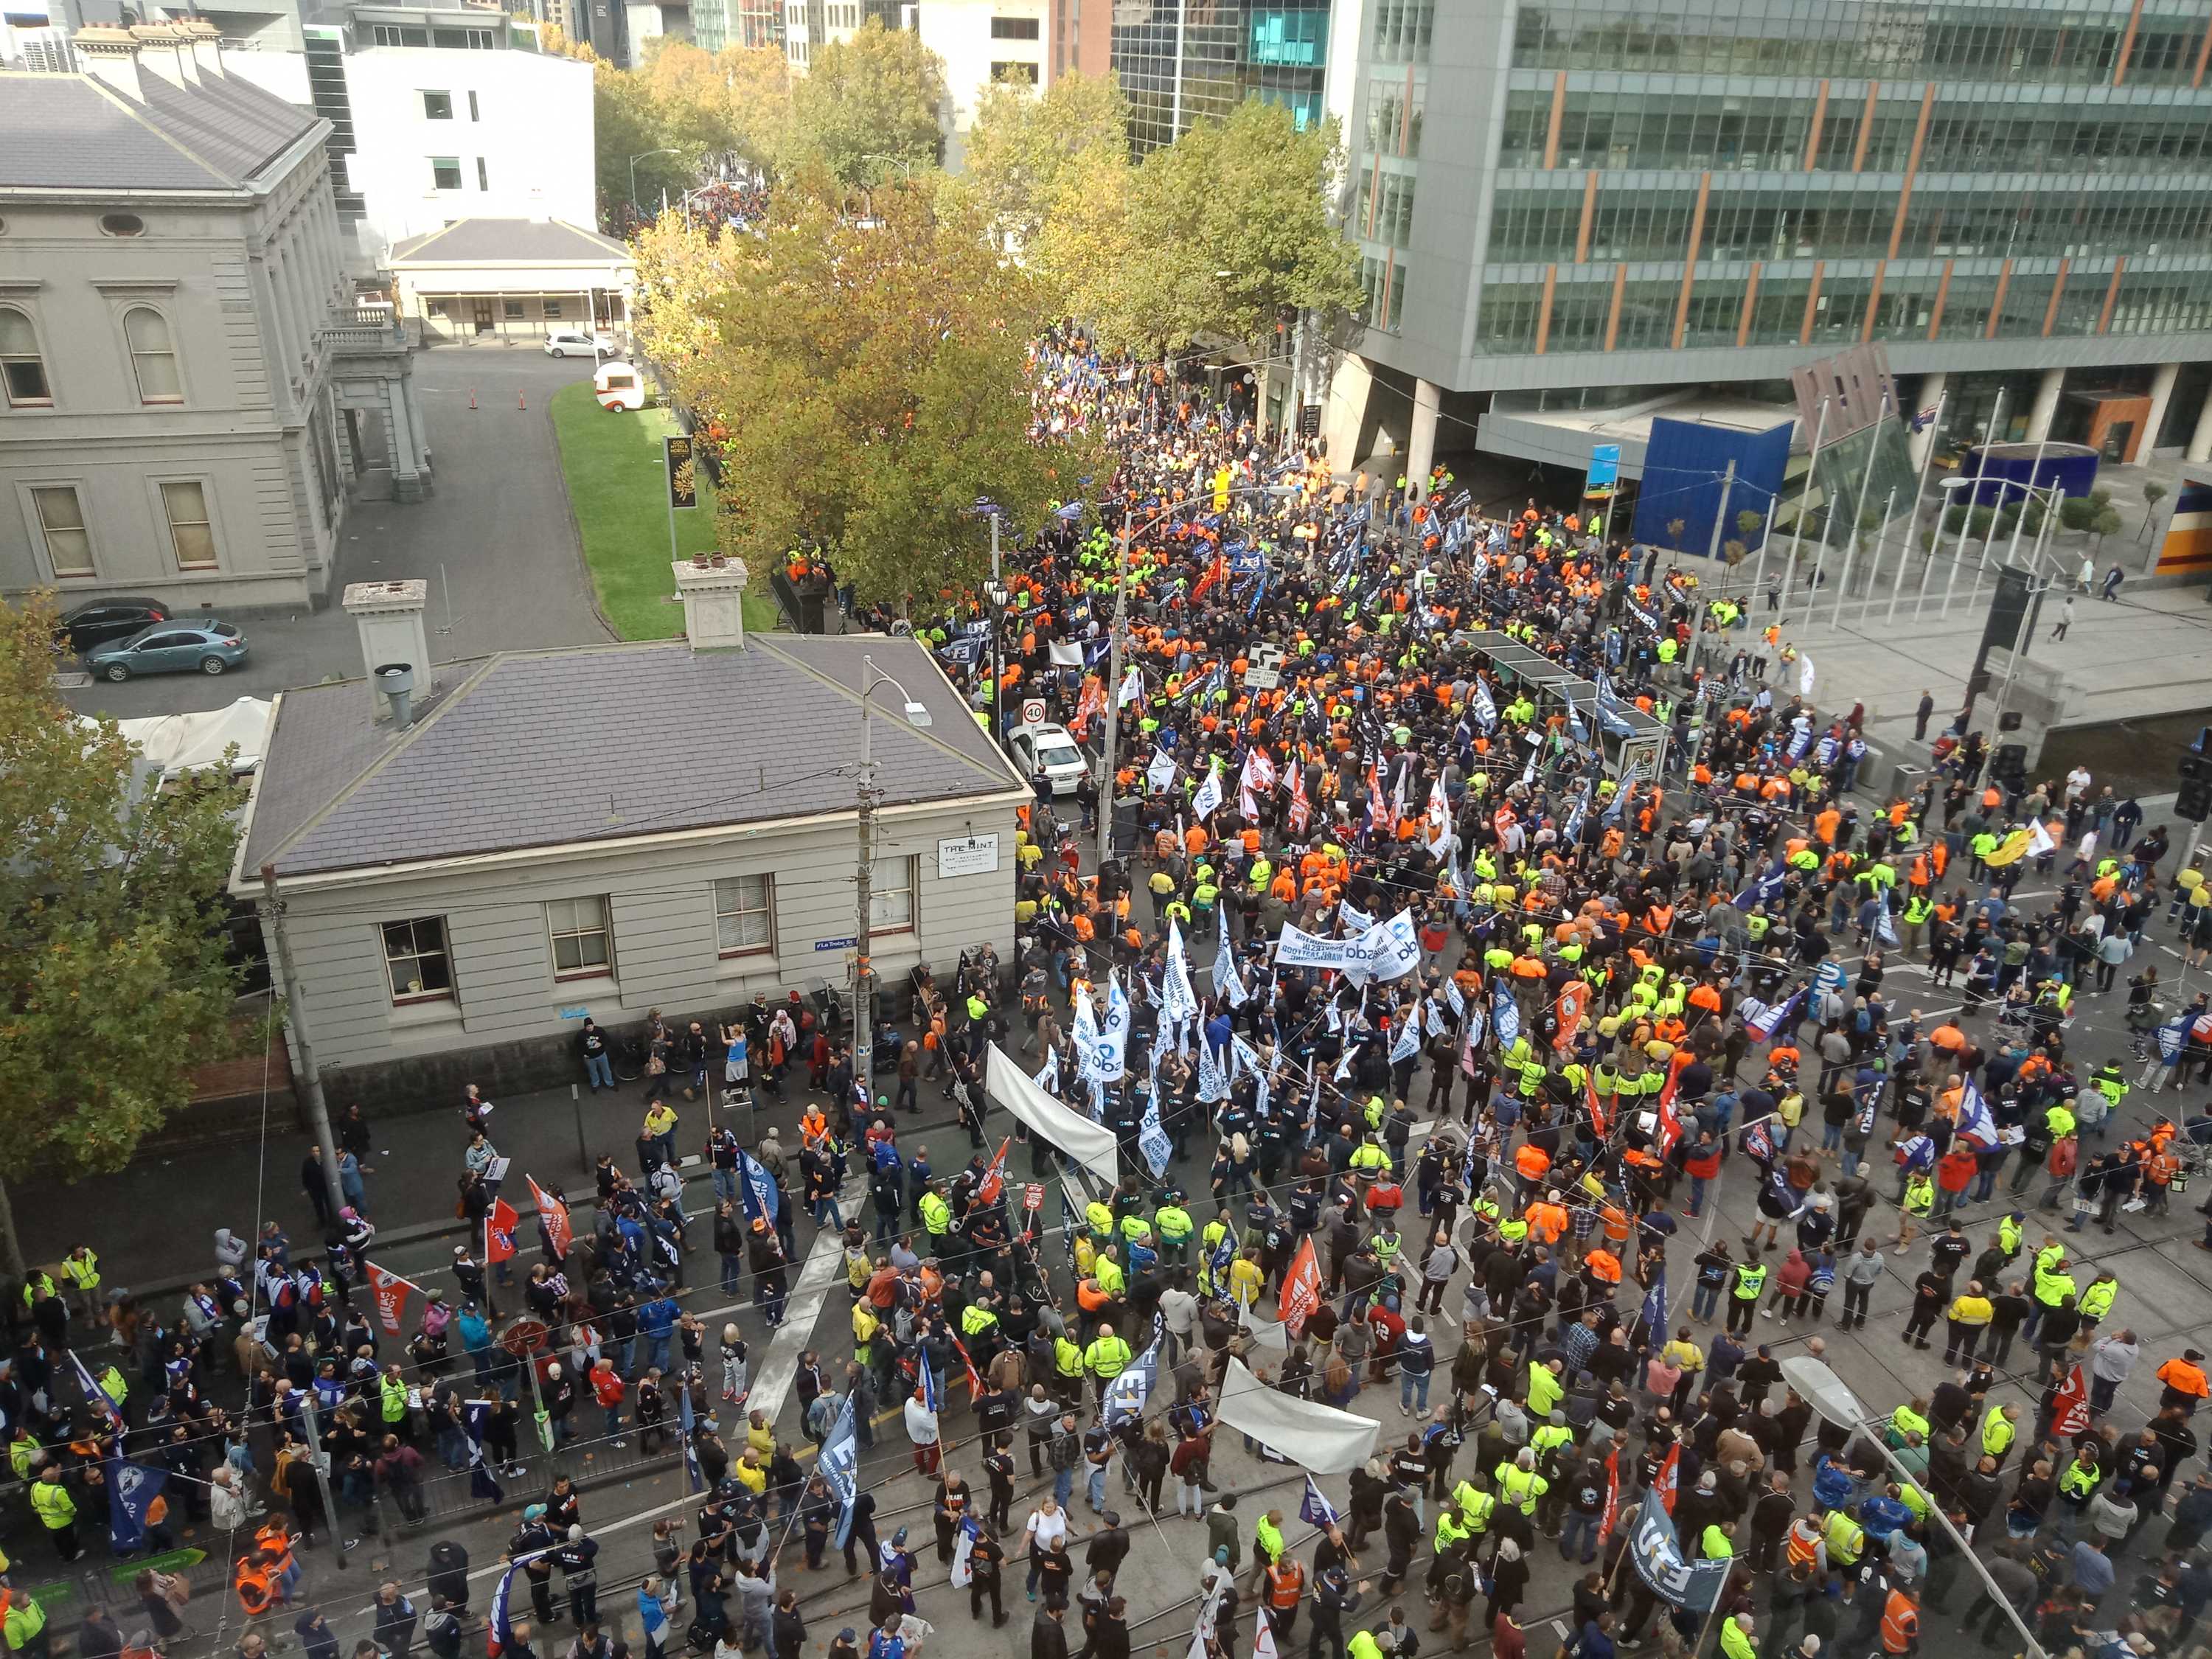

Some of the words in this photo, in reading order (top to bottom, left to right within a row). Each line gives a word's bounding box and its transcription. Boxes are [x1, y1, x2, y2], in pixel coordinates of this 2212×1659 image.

[1026, 708, 1041, 717] 40
[945, 845, 964, 853] THE
[968, 841, 993, 850] MINT
[1376, 1321, 1390, 1342] 12
